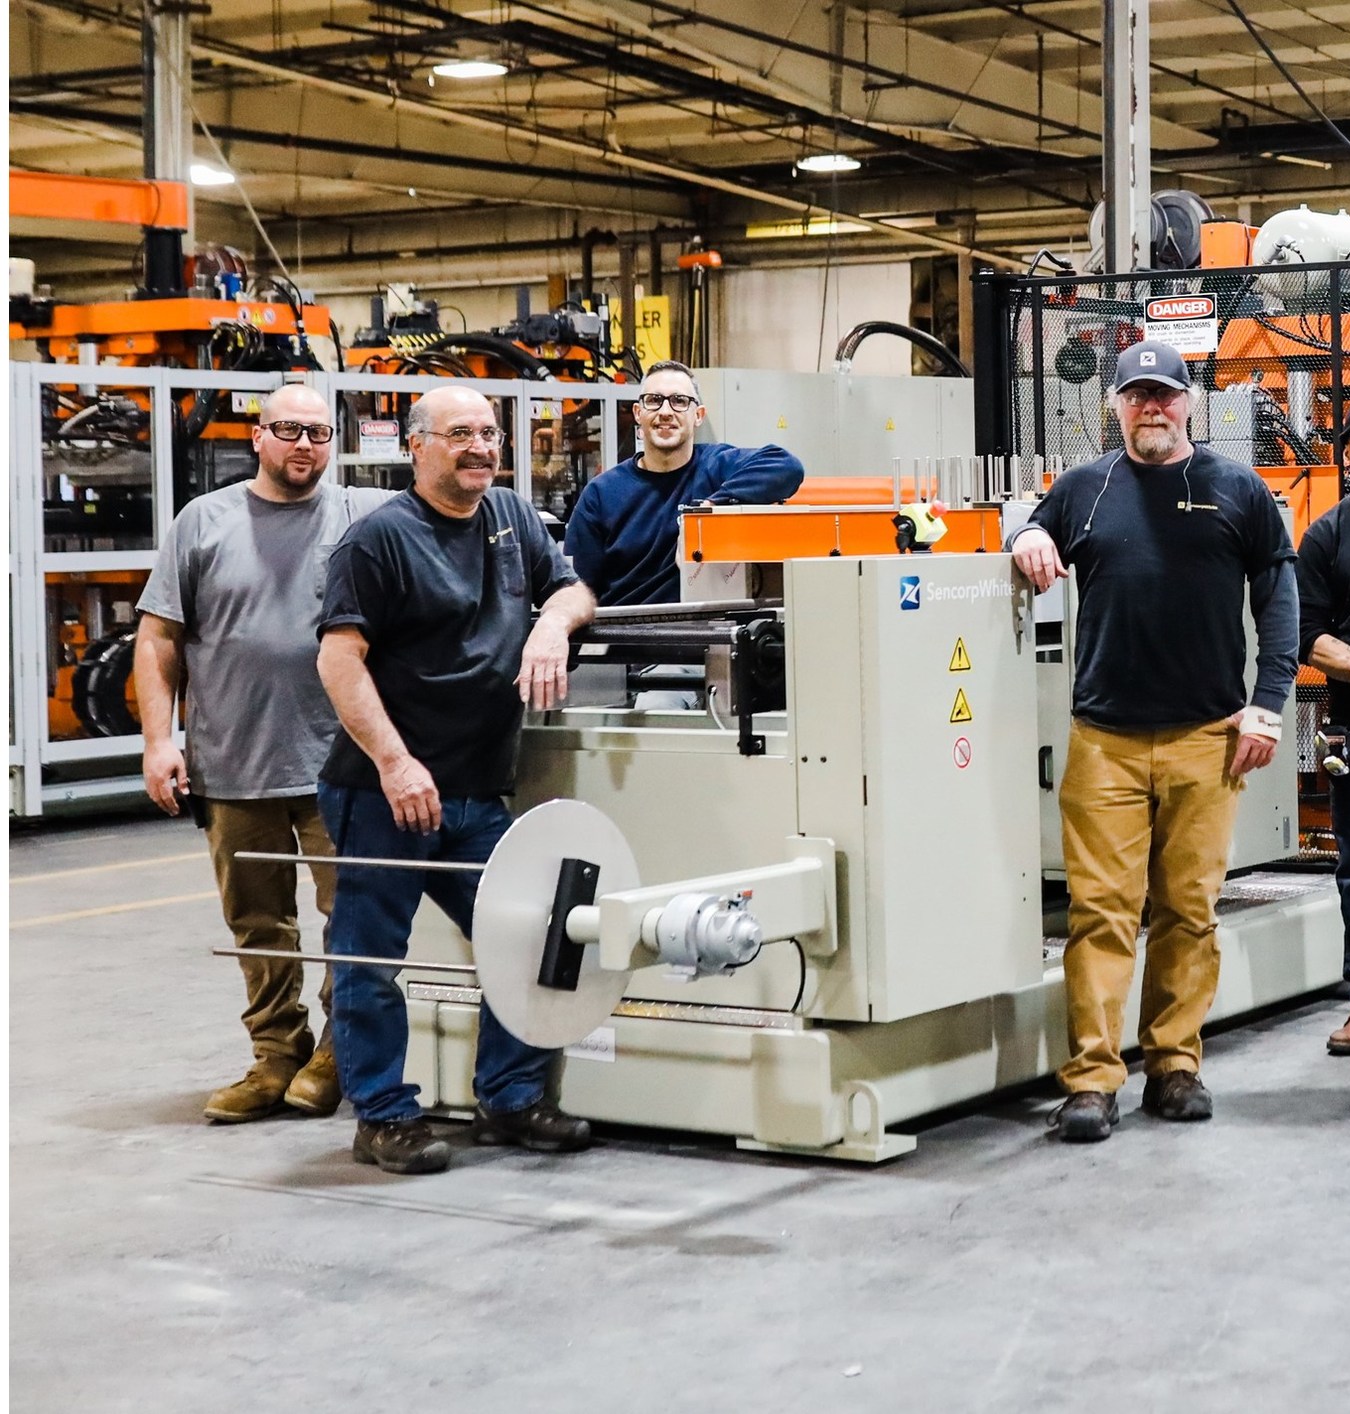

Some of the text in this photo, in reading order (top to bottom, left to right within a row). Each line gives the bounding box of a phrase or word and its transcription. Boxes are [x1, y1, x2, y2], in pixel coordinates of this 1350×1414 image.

[1153, 301, 1208, 316] DANGER
[1147, 324, 1171, 332] MOVING
[1173, 321, 1211, 330] MECHANISMS
[363, 424, 395, 434] DANGER
[926, 578, 1016, 605] SencorpWhite
